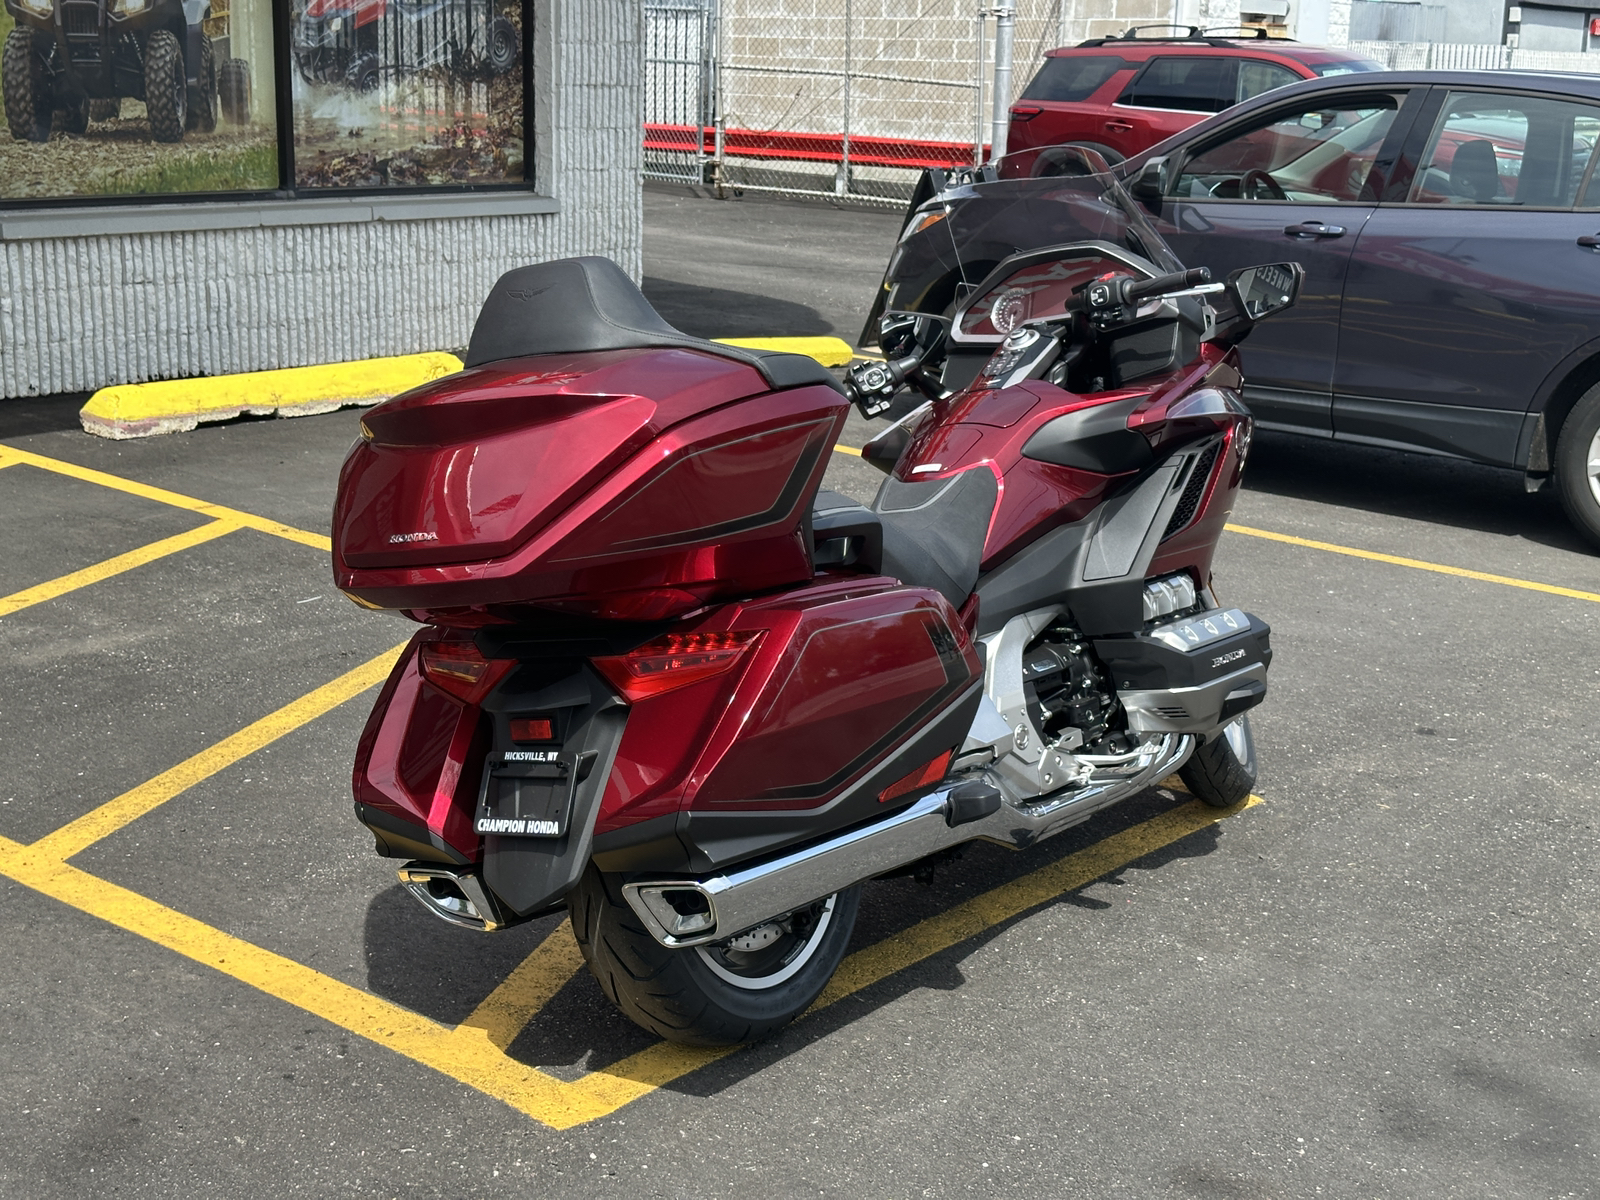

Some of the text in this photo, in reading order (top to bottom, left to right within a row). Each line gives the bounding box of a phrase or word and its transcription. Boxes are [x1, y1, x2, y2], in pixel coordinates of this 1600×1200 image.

[389, 531, 438, 543] HONDA
[504, 751, 559, 762] HICKSVILLE, NY
[477, 818, 559, 834] CHAMPION HONDA
